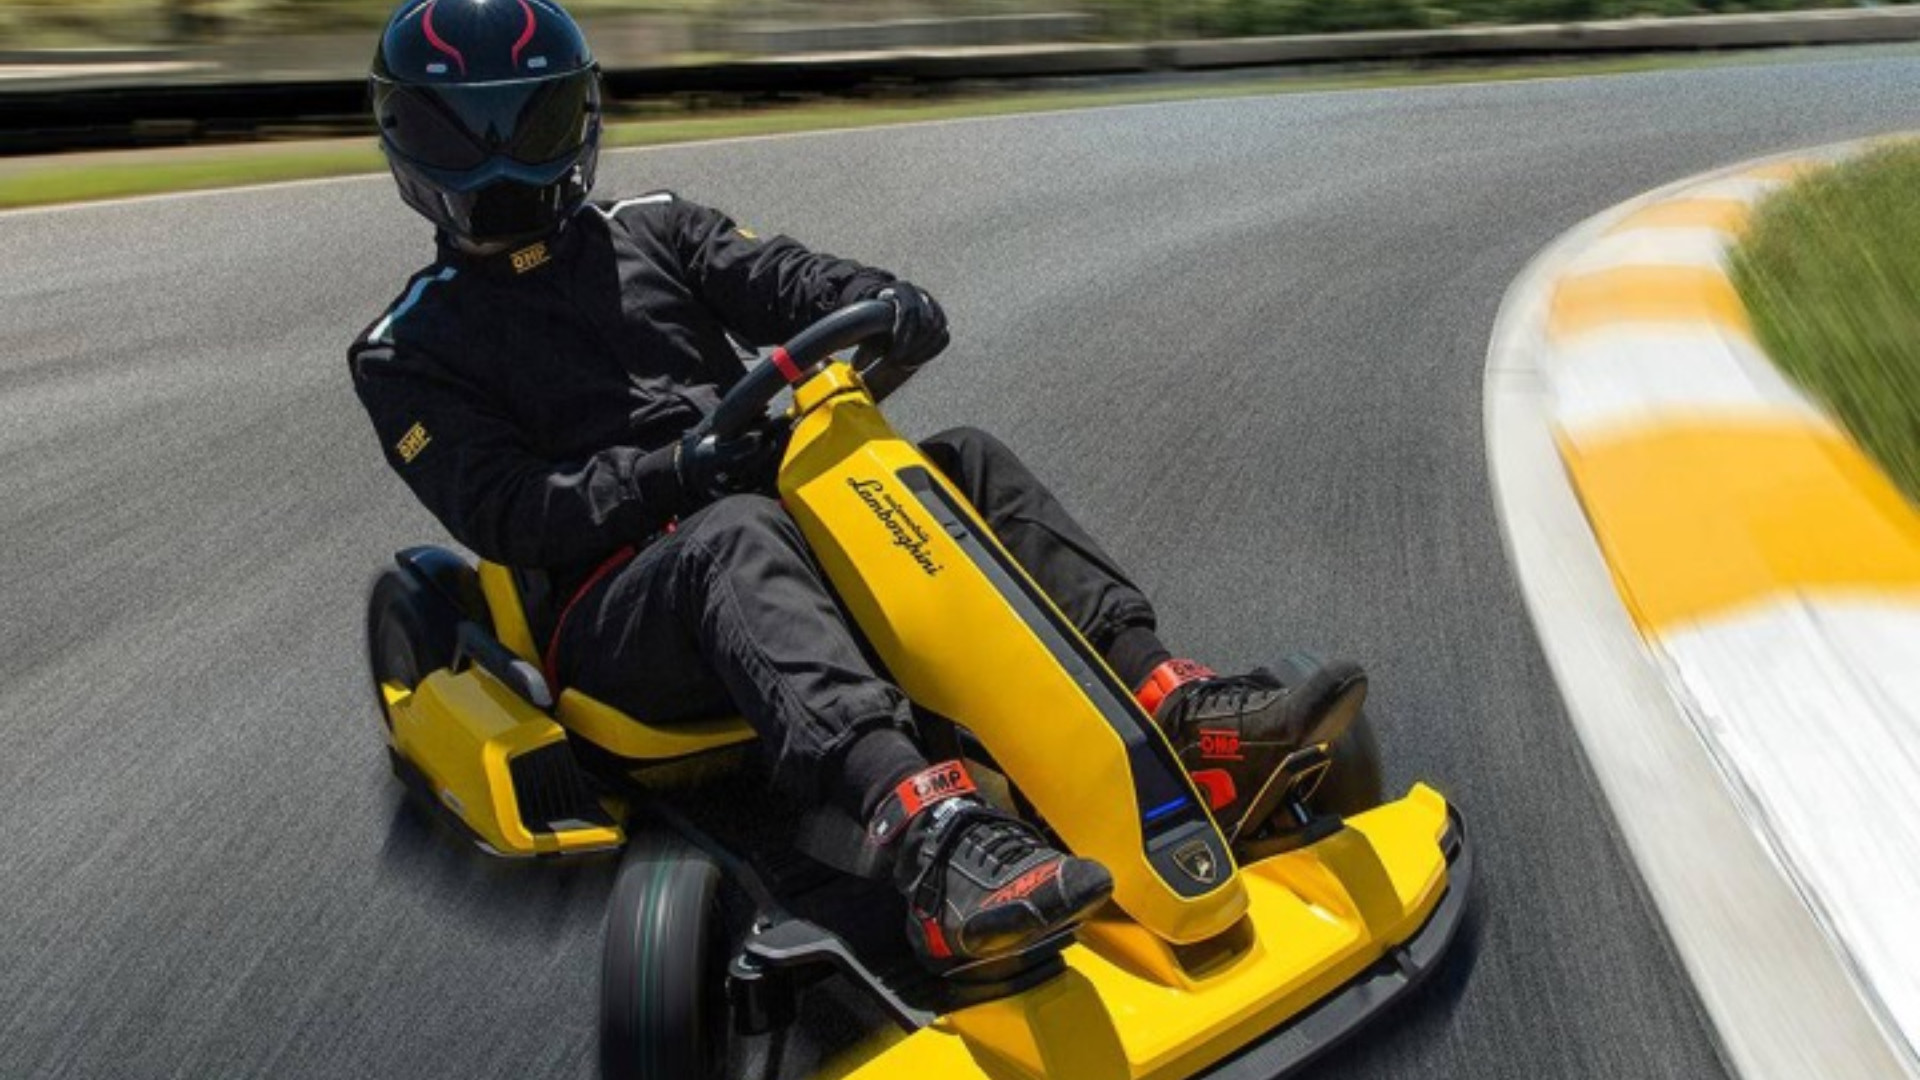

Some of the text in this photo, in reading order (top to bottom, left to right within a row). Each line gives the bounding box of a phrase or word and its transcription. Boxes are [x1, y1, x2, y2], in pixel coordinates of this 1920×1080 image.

[847, 477, 945, 575] Lamborghini
[1200, 737, 1240, 754] OMP
[914, 771, 960, 796] OMP
